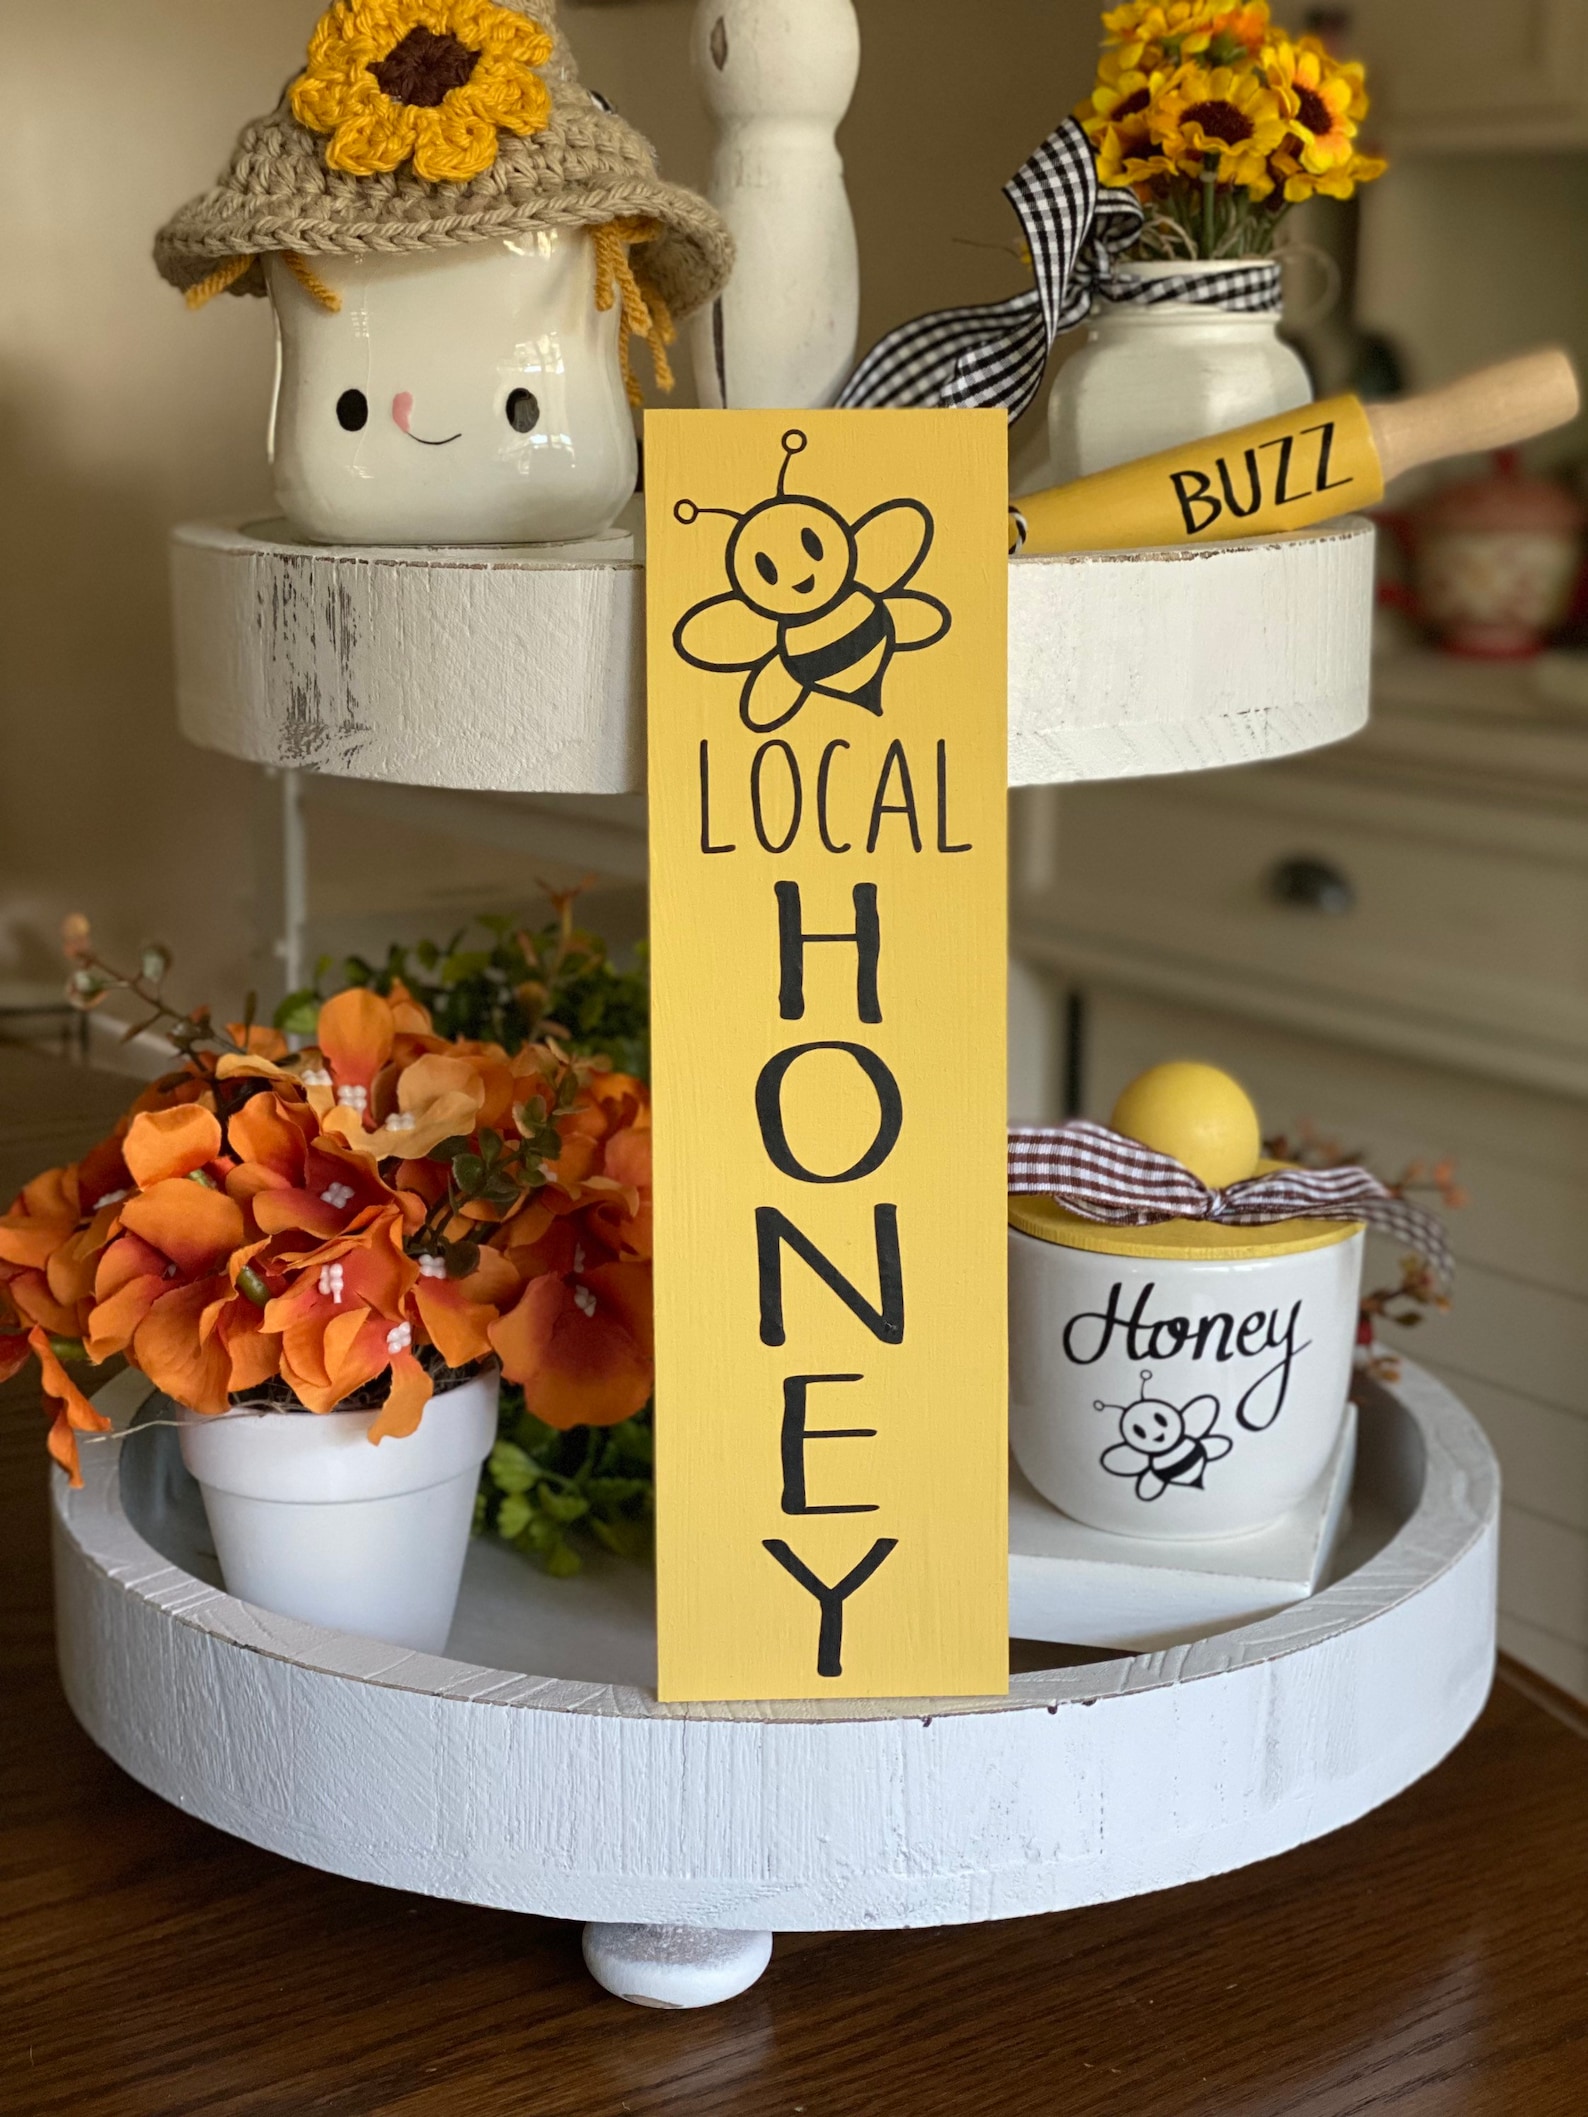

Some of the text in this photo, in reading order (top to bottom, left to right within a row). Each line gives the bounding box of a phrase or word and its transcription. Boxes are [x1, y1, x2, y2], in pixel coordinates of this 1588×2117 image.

[1170, 422, 1353, 535] BUZZ
[700, 738, 973, 854] LOCAL
[755, 881, 905, 1676] HONEY
[1063, 1282, 1312, 1432] Honey
